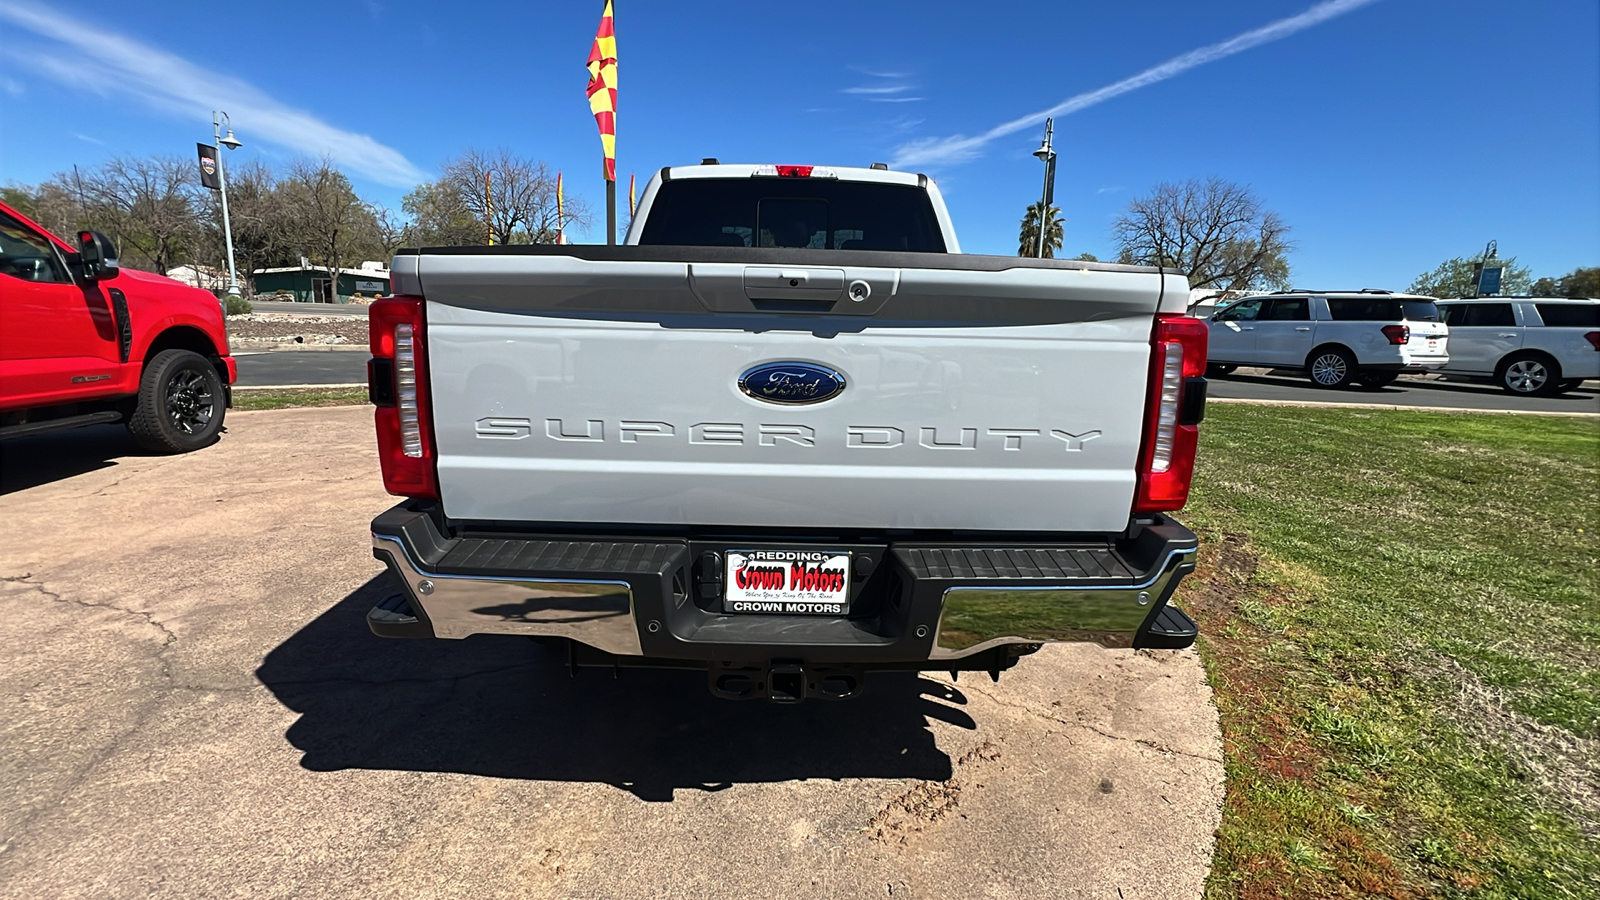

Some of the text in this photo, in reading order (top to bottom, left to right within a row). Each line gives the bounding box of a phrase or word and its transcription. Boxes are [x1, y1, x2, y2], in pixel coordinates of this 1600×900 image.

[763, 371, 820, 396] Ford
[475, 416, 1102, 451] SUPER DUTY
[756, 551, 822, 561] REDDING
[735, 562, 844, 592] Crown Motors
[733, 602, 841, 613] CROWN MOTORS
